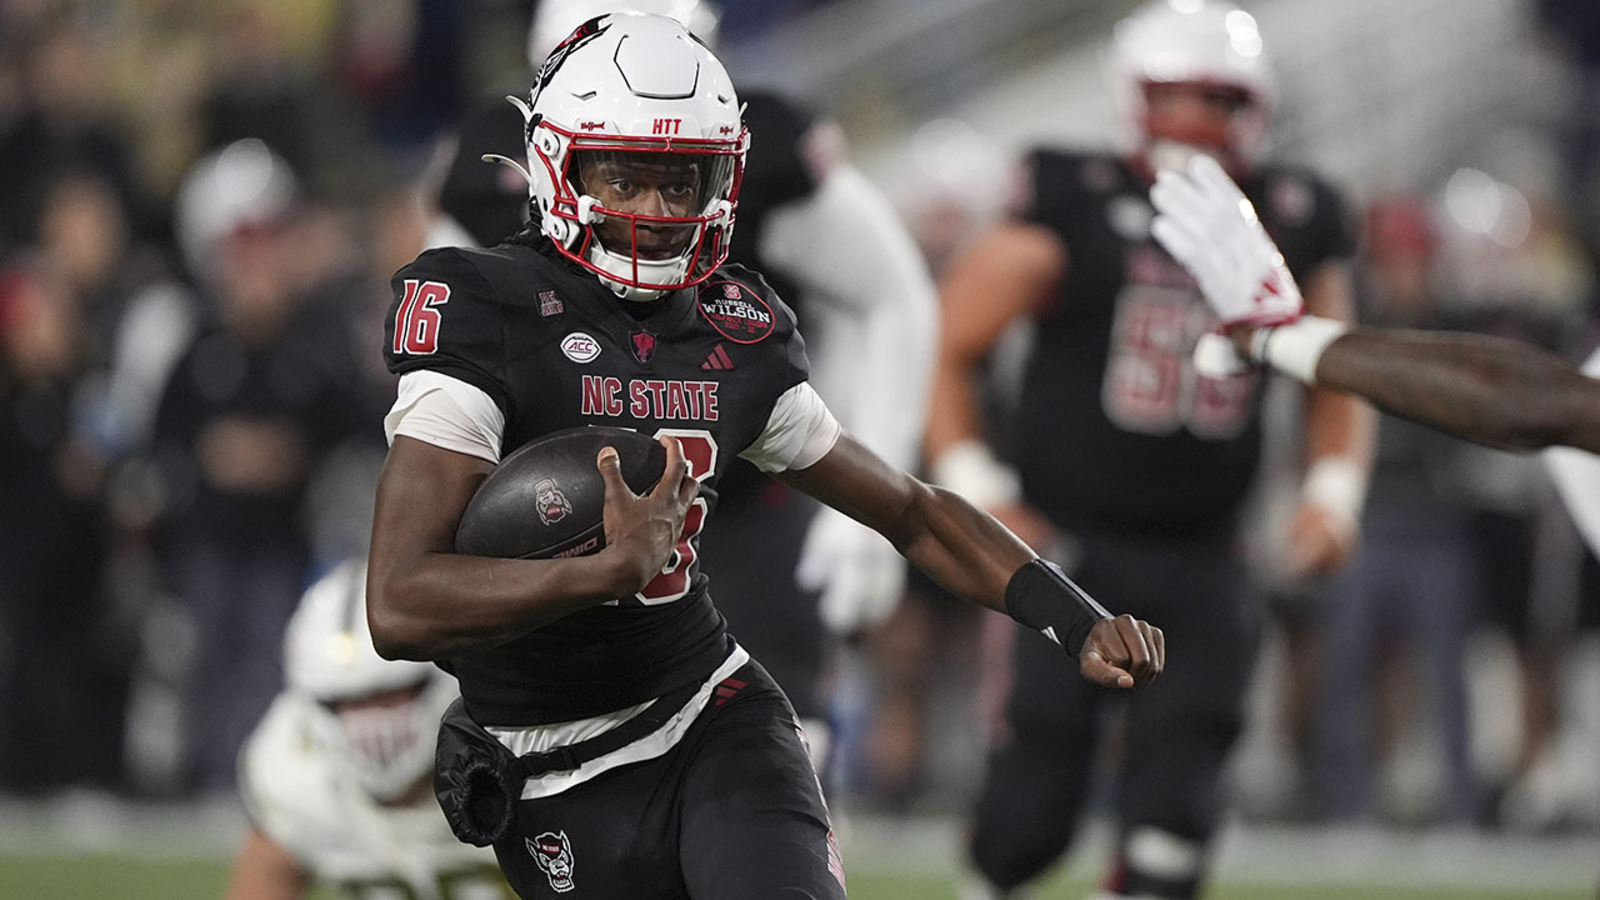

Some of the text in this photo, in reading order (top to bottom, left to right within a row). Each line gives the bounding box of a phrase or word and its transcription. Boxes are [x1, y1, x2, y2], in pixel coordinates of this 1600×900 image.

[652, 118, 682, 135] HTT
[393, 279, 451, 355] 16
[702, 303, 771, 323] WILSON
[568, 341, 594, 352] ACC
[581, 375, 719, 421] NC STATE
